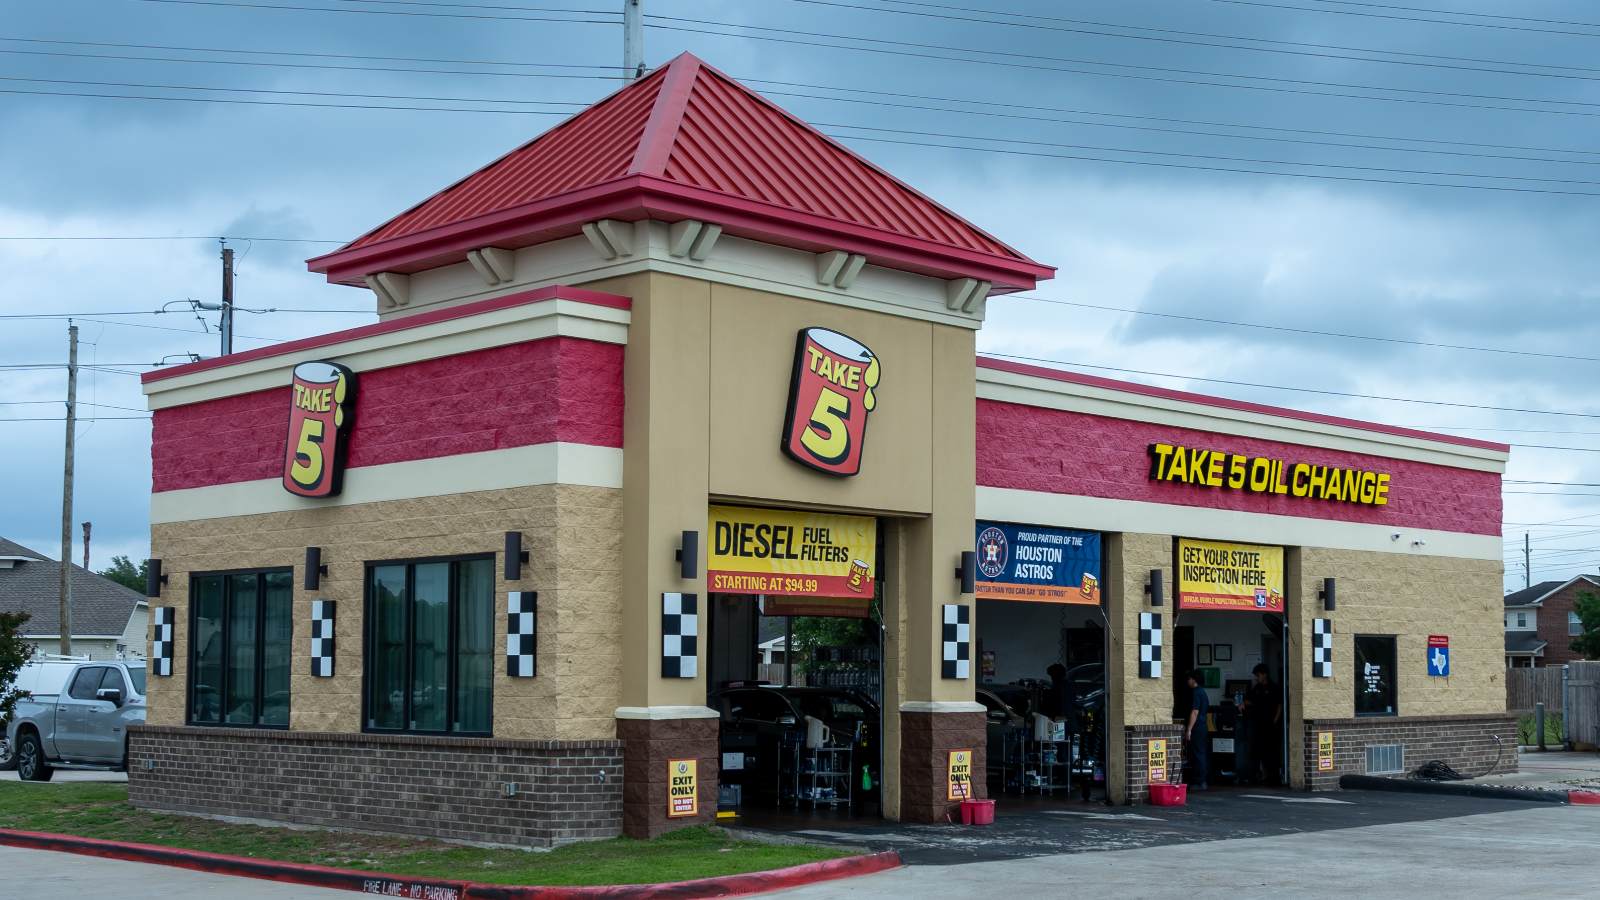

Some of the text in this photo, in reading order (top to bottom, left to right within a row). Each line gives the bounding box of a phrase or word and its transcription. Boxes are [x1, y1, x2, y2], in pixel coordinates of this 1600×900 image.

[808, 345, 862, 391] TAKE
[295, 383, 332, 412] TAKE
[800, 387, 849, 460] 5
[290, 418, 323, 486] 5
[1154, 443, 1391, 505] TAKE 5 OIL CHANGE
[714, 520, 799, 560] DIESEL
[802, 527, 833, 545] FUEL
[1017, 531, 1083, 546] PROUD PARTNER OF THE
[800, 545, 849, 563] FILTERS
[986, 544, 998, 561] H
[1015, 545, 1062, 563] HOUSTON
[1183, 546, 1260, 569] GET YOUR STATE
[851, 563, 866, 576] TAKE
[1014, 562, 1054, 580] ASTROS
[1183, 565, 1266, 586] INSPECTION HERE
[714, 574, 818, 592] STARTING AT $94.99
[851, 573, 861, 586] 5
[1082, 584, 1091, 594] 5
[1149, 759, 1165, 767] ONLY
[1150, 751, 1164, 759] EXIT
[952, 765, 968, 773] EXIT
[673, 776, 693, 785] EXIT
[671, 786, 694, 795] ONLY
[363, 880, 458, 900] FIRE LANE NO PARKING
